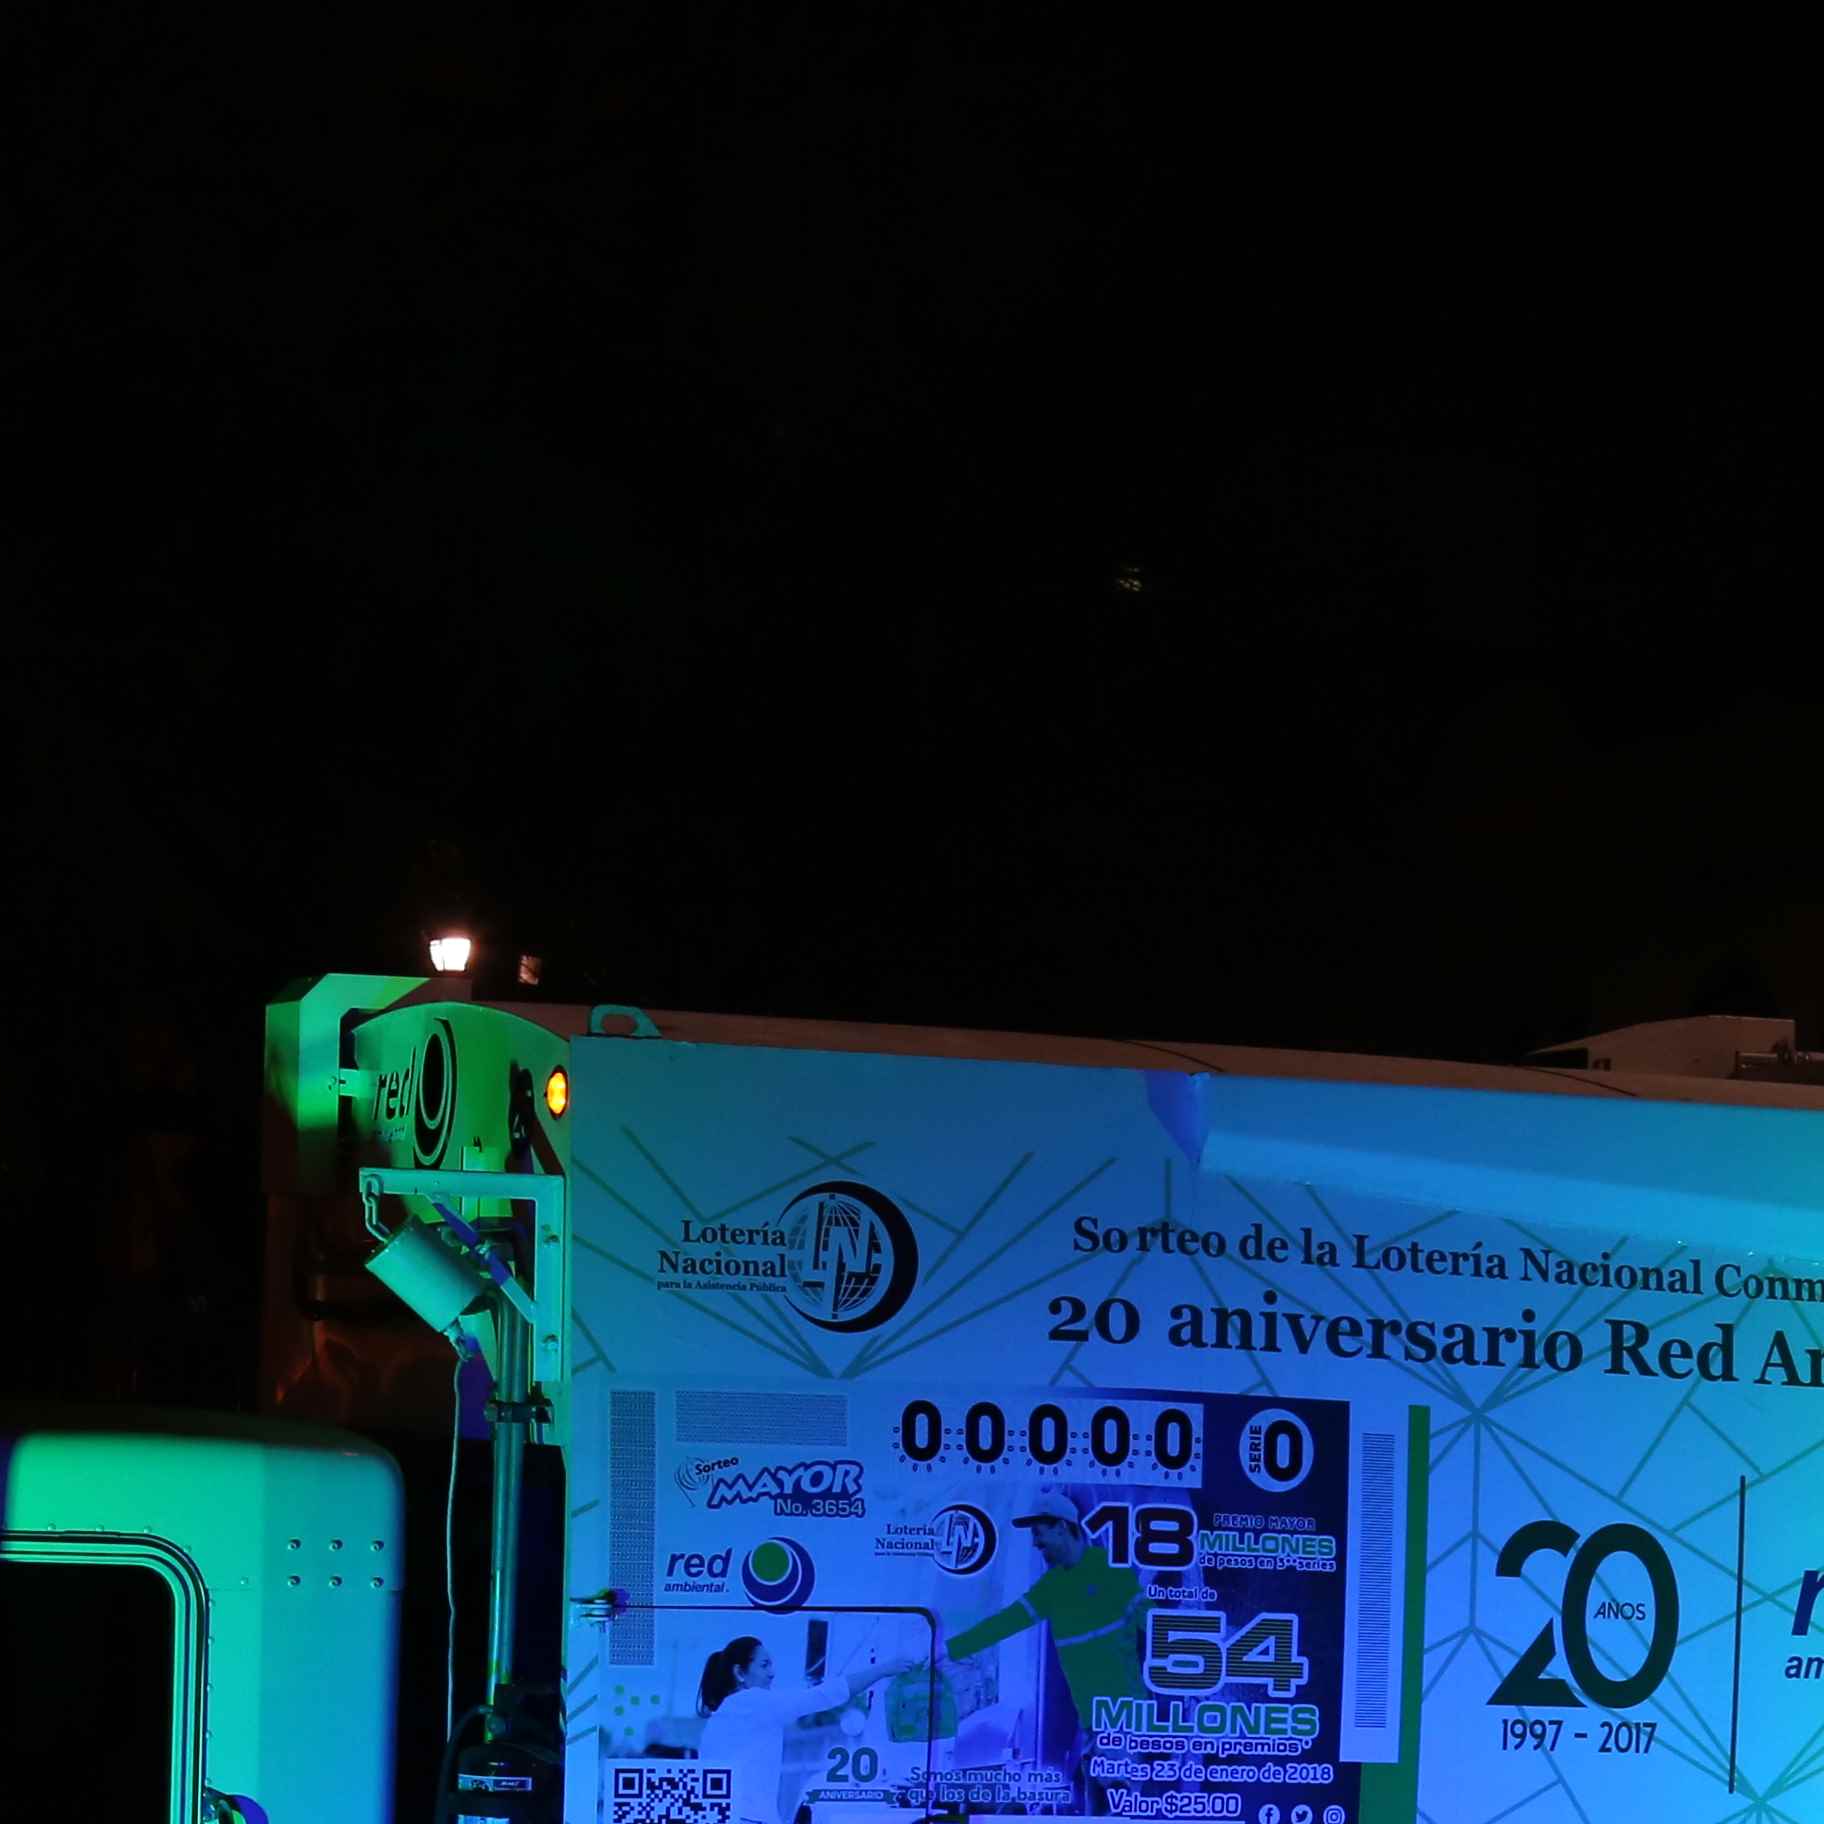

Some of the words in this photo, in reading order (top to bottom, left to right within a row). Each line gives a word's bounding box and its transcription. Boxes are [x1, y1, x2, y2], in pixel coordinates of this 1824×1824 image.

[374, 1046, 416, 1120] red
[681, 1219, 787, 1247] Lotería
[657, 1249, 788, 1278] Nacional
[1074, 1215, 1227, 1258] Sorteo
[1238, 1224, 1290, 1263] de
[1301, 1228, 1339, 1267] la
[1352, 1234, 1508, 1280] Lotería
[1519, 1246, 1702, 1295] Nacional
[1048, 1296, 1140, 1344] 20
[1169, 1290, 1583, 1372] aniversario
[1604, 1318, 1740, 1383] Red
[1249, 1425, 1262, 1473] SERIE
[1264, 1420, 1303, 1482] 0
[695, 1457, 739, 1475] Sorteo
[709, 1462, 862, 1507] MAYOR
[776, 1500, 807, 1515] No.
[813, 1500, 863, 1516] 3654
[1214, 1513, 1265, 1528] PREMIO
[1269, 1515, 1316, 1530] MAYOR
[875, 1538, 934, 1550] Nacional
[1084, 1503, 1196, 1571] 18
[1199, 1530, 1336, 1558] MILLONES
[666, 1548, 733, 1579] red
[1200, 1553, 1214, 1567] de
[1217, 1555, 1255, 1570] pesos
[1257, 1557, 1274, 1569] en
[1149, 1585, 1166, 1599] Un
[1168, 1586, 1198, 1600] total
[1201, 1587, 1216, 1600] de
[1486, 1520, 1680, 1709] 20
[1144, 1609, 1309, 1696] 54
[1092, 1697, 1319, 1738] MILLONES
[1098, 1733, 1124, 1749] de
[1127, 1736, 1187, 1752] pesos
[1191, 1738, 1217, 1753] en
[1501, 1718, 1564, 1752] 1997
[1598, 1721, 1658, 1754] 2017
[828, 1747, 878, 1783] 20
[910, 1766, 962, 1783] Somos
[967, 1767, 1022, 1783] mucho
[1091, 1757, 1151, 1780] Martes
[1152, 1762, 1179, 1780] 23
[1181, 1763, 1204, 1781] de
[1207, 1767, 1257, 1782] enero
[1260, 1764, 1283, 1782] de
[1285, 1764, 1334, 1784] 2018
[819, 1790, 884, 1800] ANIVERSARIO
[908, 1788, 935, 1804] que
[941, 1785, 965, 1801] los
[968, 1786, 992, 1801] de
[995, 1786, 1011, 1801] la
[1016, 1786, 1073, 1802] basura
[1107, 1789, 1161, 1815] Valor
[1163, 1791, 1242, 1817] $25.00
